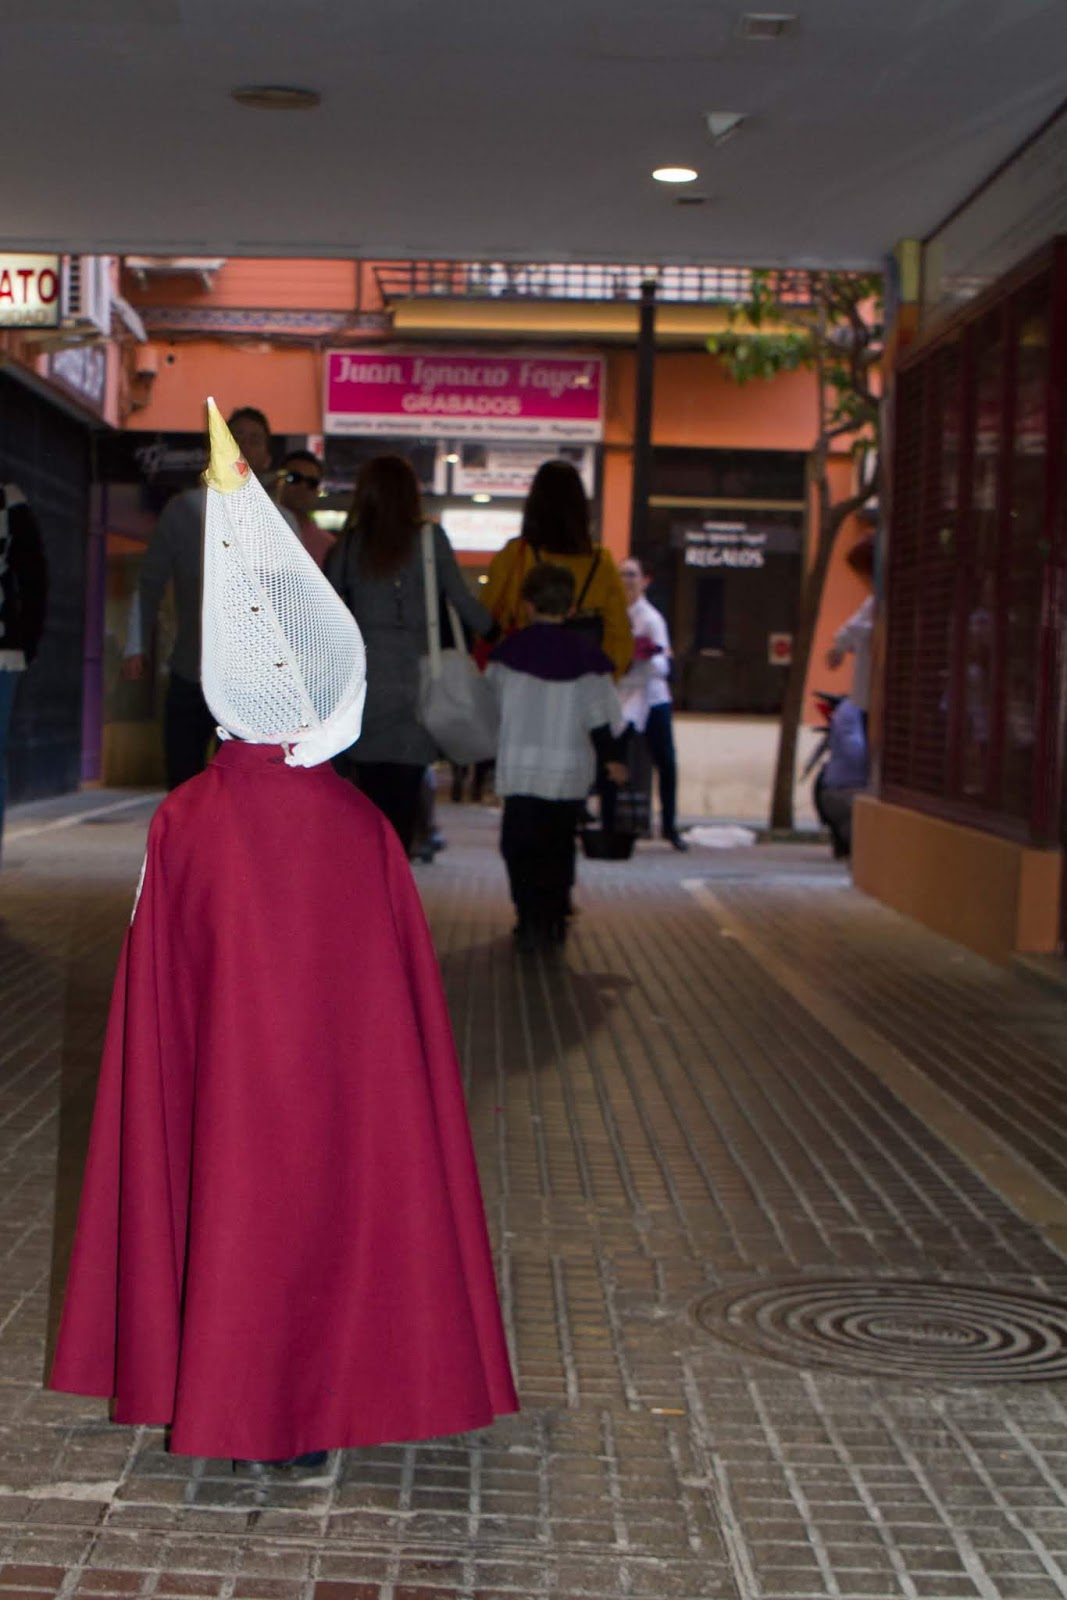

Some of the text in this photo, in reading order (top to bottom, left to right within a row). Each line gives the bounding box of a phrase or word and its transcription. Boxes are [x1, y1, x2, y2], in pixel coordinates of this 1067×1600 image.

[333, 355, 405, 384] Juan
[412, 357, 510, 394] Ignacio
[401, 392, 522, 416] GRABADOS
[684, 550, 765, 569] REGALOS
